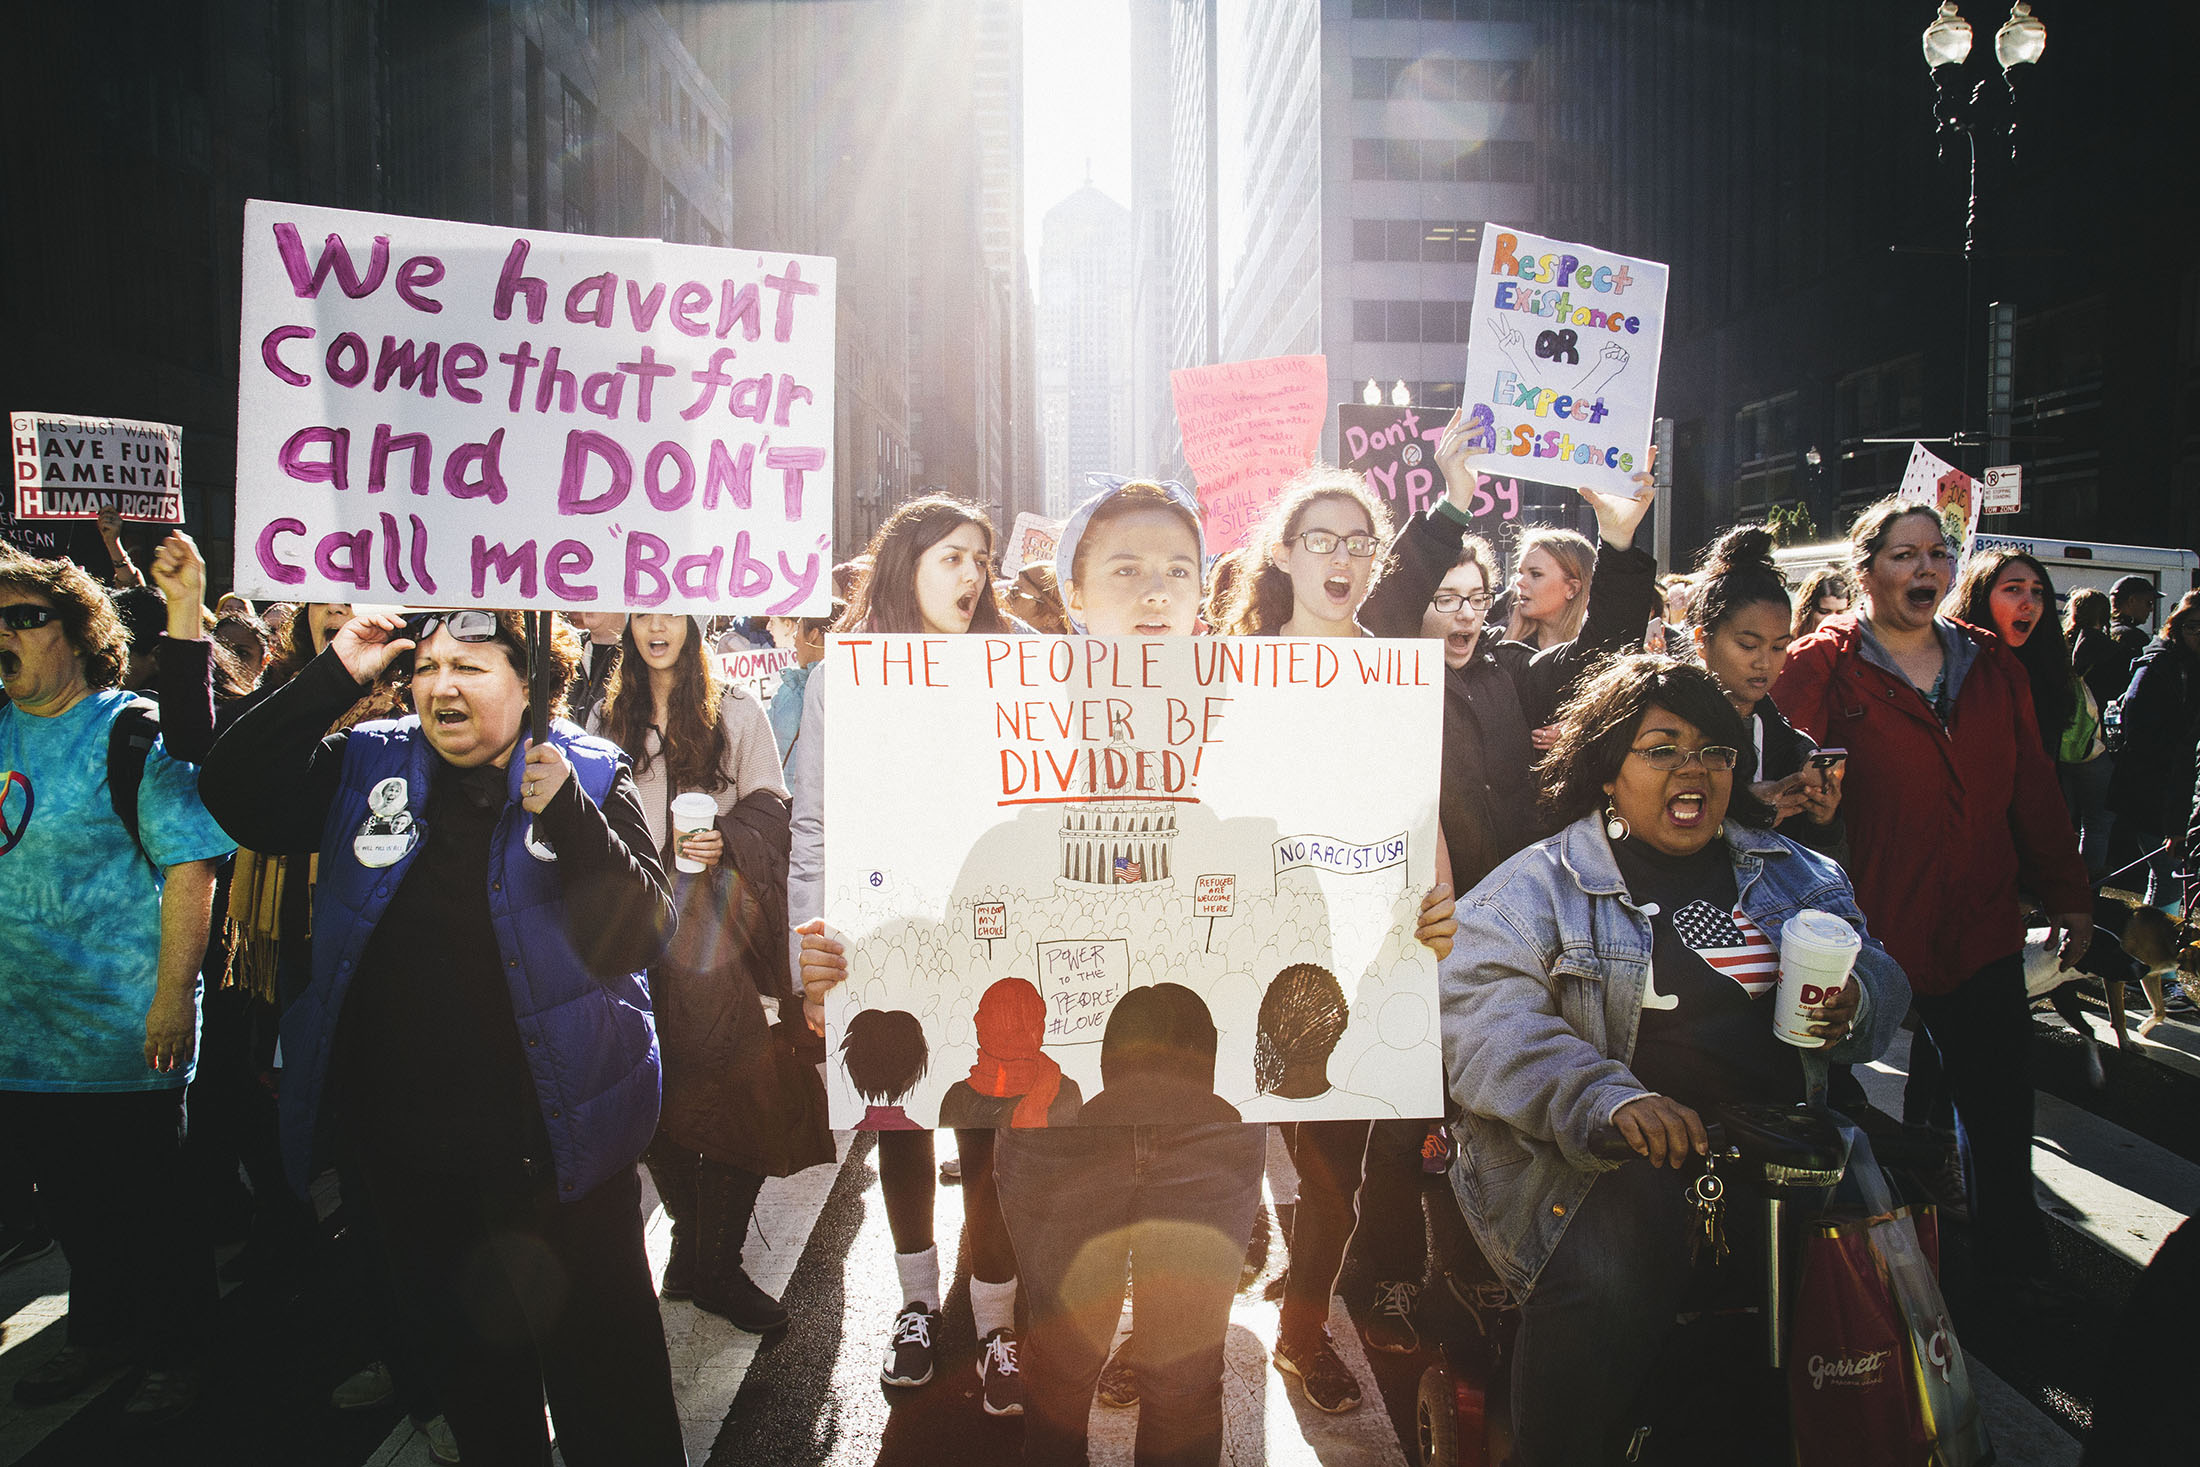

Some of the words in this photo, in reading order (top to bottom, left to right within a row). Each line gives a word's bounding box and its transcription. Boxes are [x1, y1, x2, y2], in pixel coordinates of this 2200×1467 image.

[273, 222, 445, 314] We
[493, 238, 819, 343] haven't
[1495, 282, 1640, 334] Existance
[1535, 329, 1579, 364] OR
[499, 341, 676, 423] that
[680, 347, 813, 427] far
[14, 418, 67, 433] GIRLS
[77, 422, 115, 436] JUST
[123, 425, 179, 441] WANNA
[16, 437, 104, 460] HAVE
[19, 462, 180, 488] DAMENTAL
[278, 424, 508, 504] and
[558, 429, 825, 522] DON'T
[23, 491, 117, 515] HUMAN
[121, 494, 177, 519] RIGHTS
[1226, 489, 1257, 512] WILL
[256, 512, 437, 594] call
[471, 534, 598, 601] me
[838, 640, 949, 688] THE
[986, 639, 1164, 688] PEOPLE
[1194, 641, 1339, 688] UNITED
[1353, 648, 1430, 686] WILL
[996, 698, 1134, 741] NEVER
[1167, 697, 1234, 744] BE
[998, 746, 1202, 797] DIVIDED!
[1280, 842, 1305, 865] NO
[1310, 843, 1371, 868] RACIST
[1376, 840, 1404, 863] USA
[979, 916, 997, 924] MY
[1203, 905, 1229, 913] HERE
[978, 926, 1003, 936] CHOICE
[1045, 945, 1105, 974] POWER
[1077, 969, 1105, 982] THE
[1048, 1011, 1104, 1035] #LOVE
